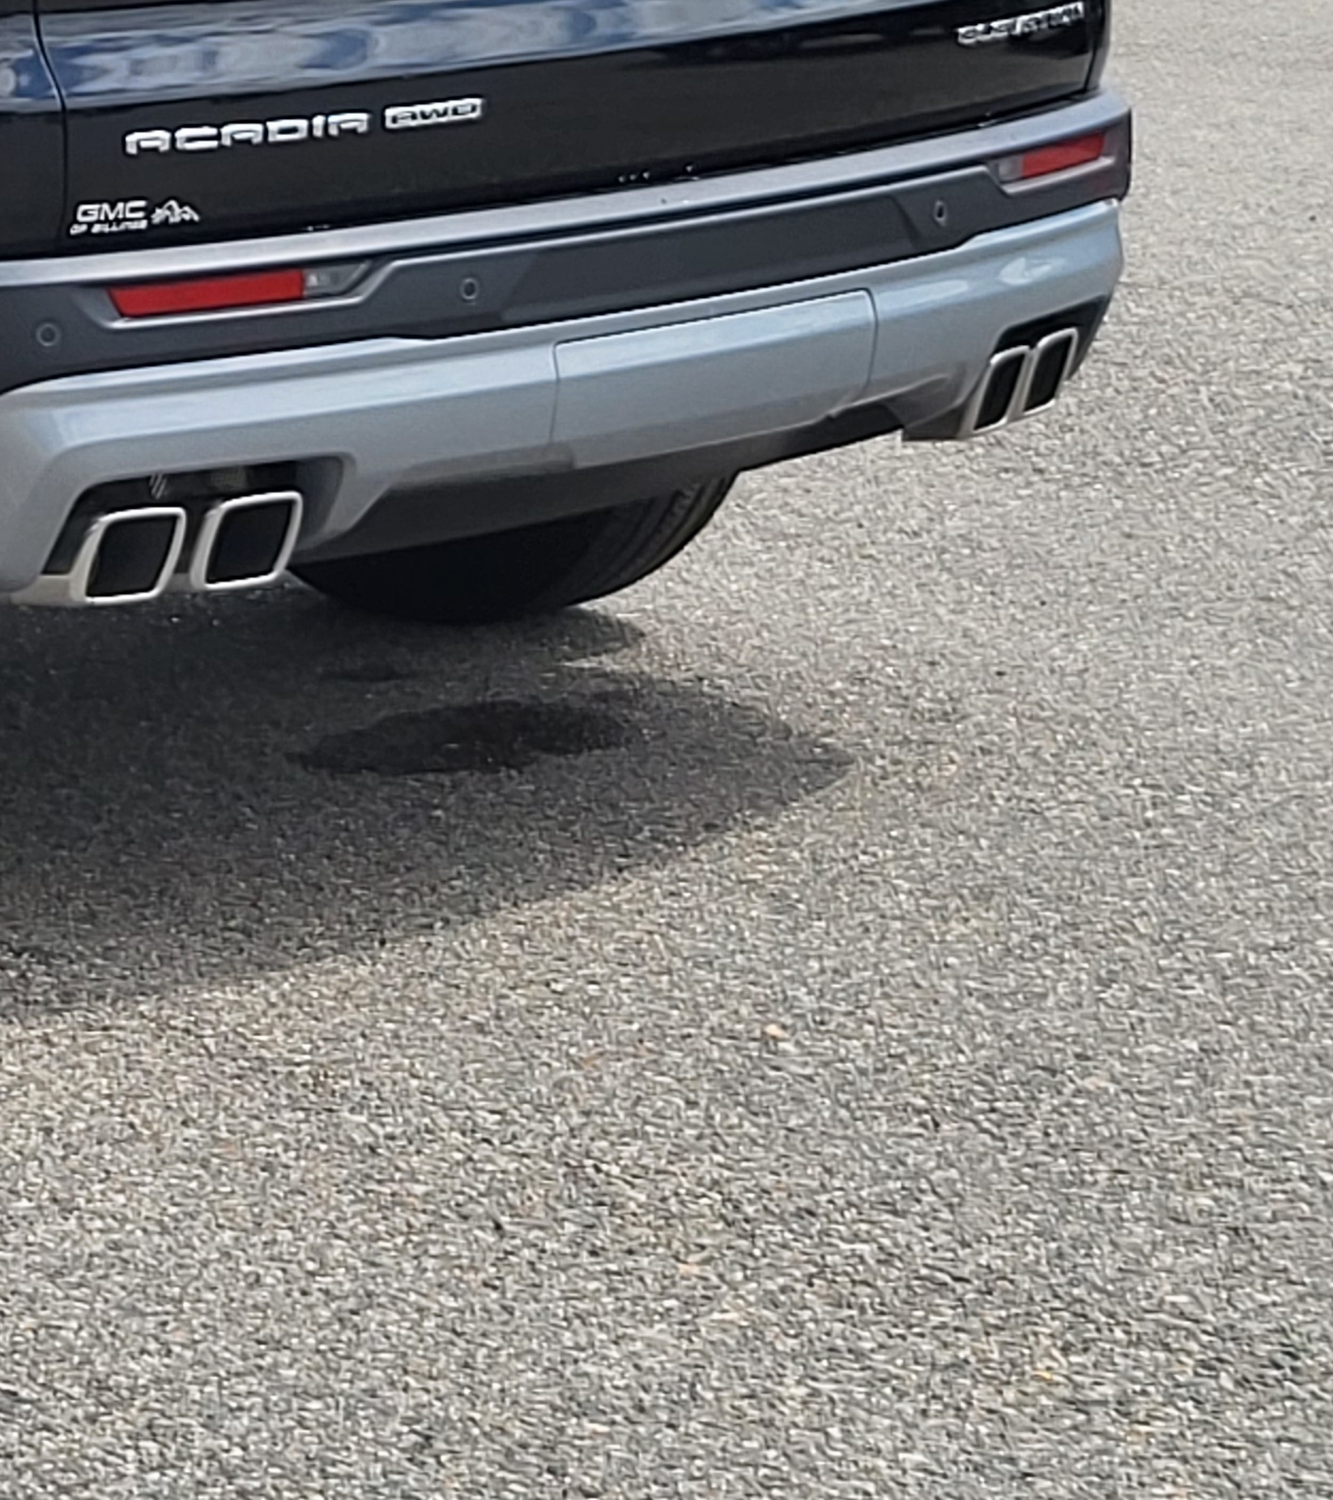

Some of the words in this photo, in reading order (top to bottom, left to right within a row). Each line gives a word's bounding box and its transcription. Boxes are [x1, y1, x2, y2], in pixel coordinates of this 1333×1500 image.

[125, 111, 370, 155] ACADIA
[389, 100, 480, 127] AWD
[76, 200, 147, 222] GMC
